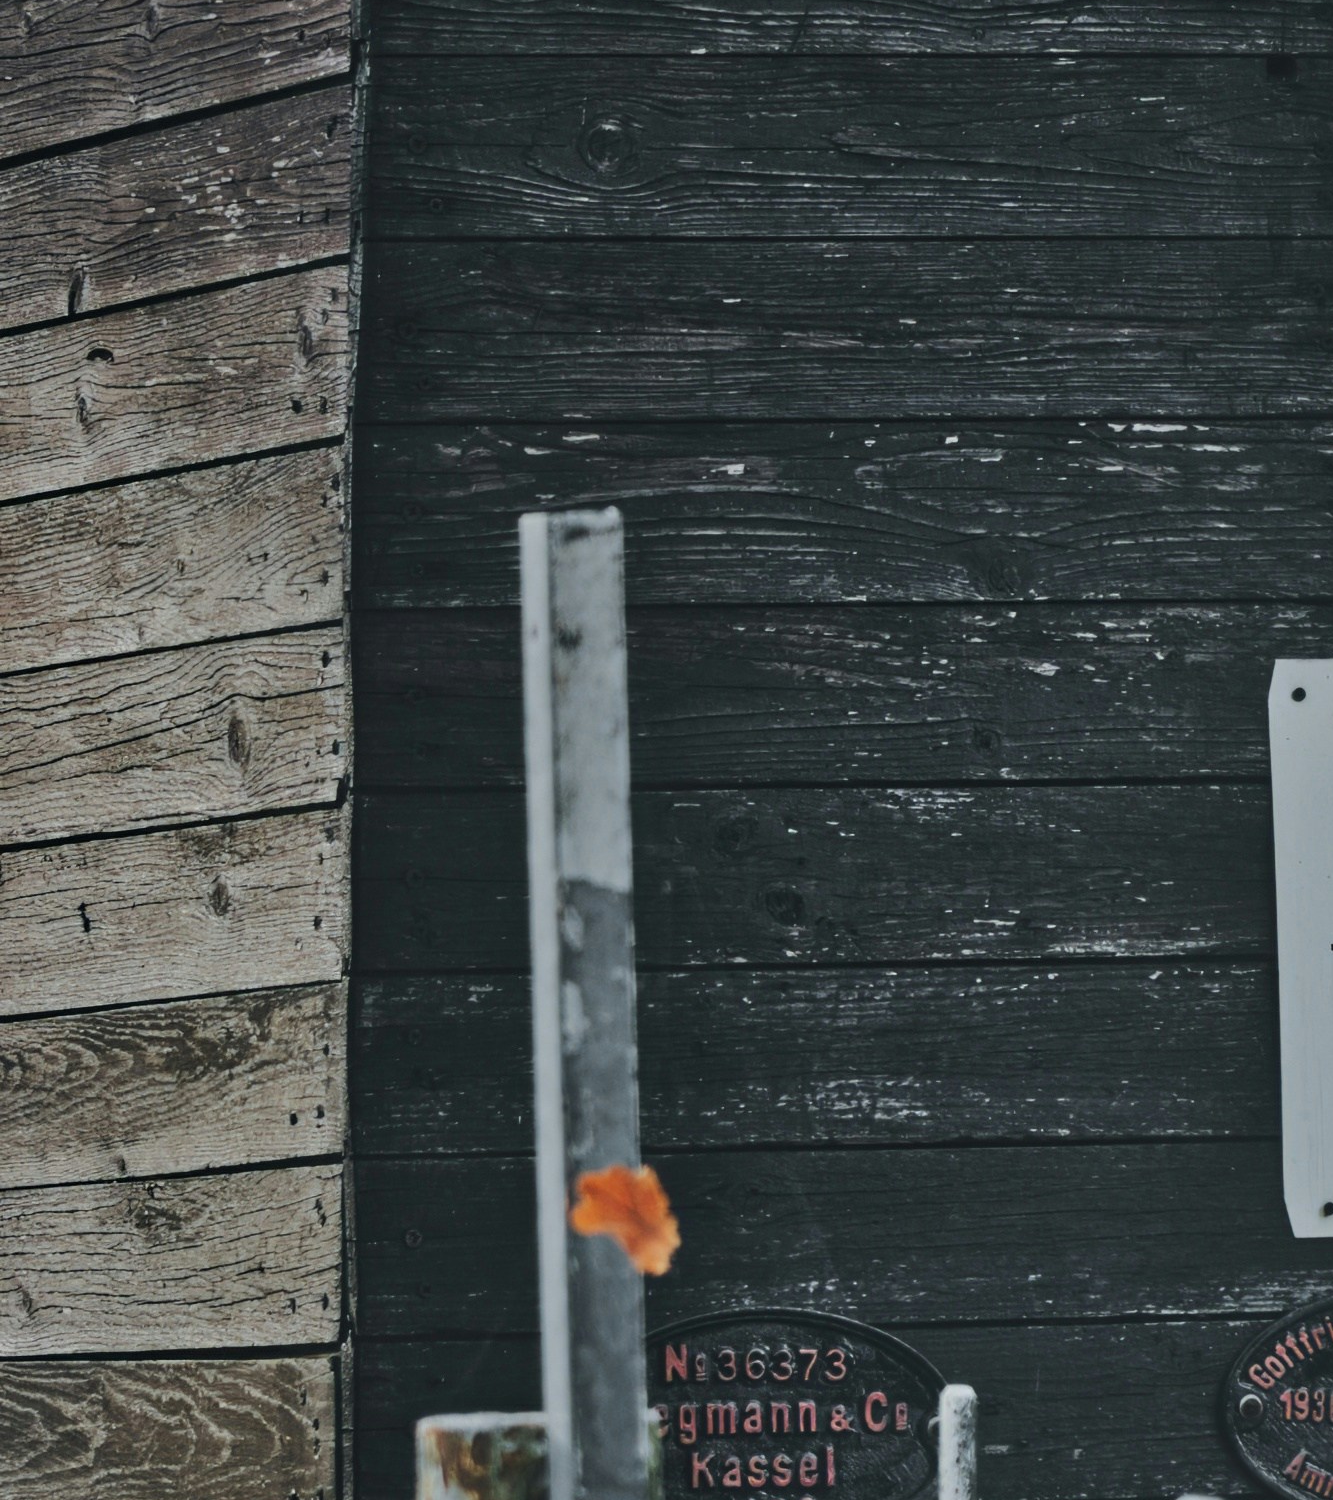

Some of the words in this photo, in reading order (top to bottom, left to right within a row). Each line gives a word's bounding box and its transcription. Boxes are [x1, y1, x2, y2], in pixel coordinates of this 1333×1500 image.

[650, 1399, 818, 1446] egmann
[829, 1403, 852, 1432] &
[691, 1444, 836, 1489] Kassel
